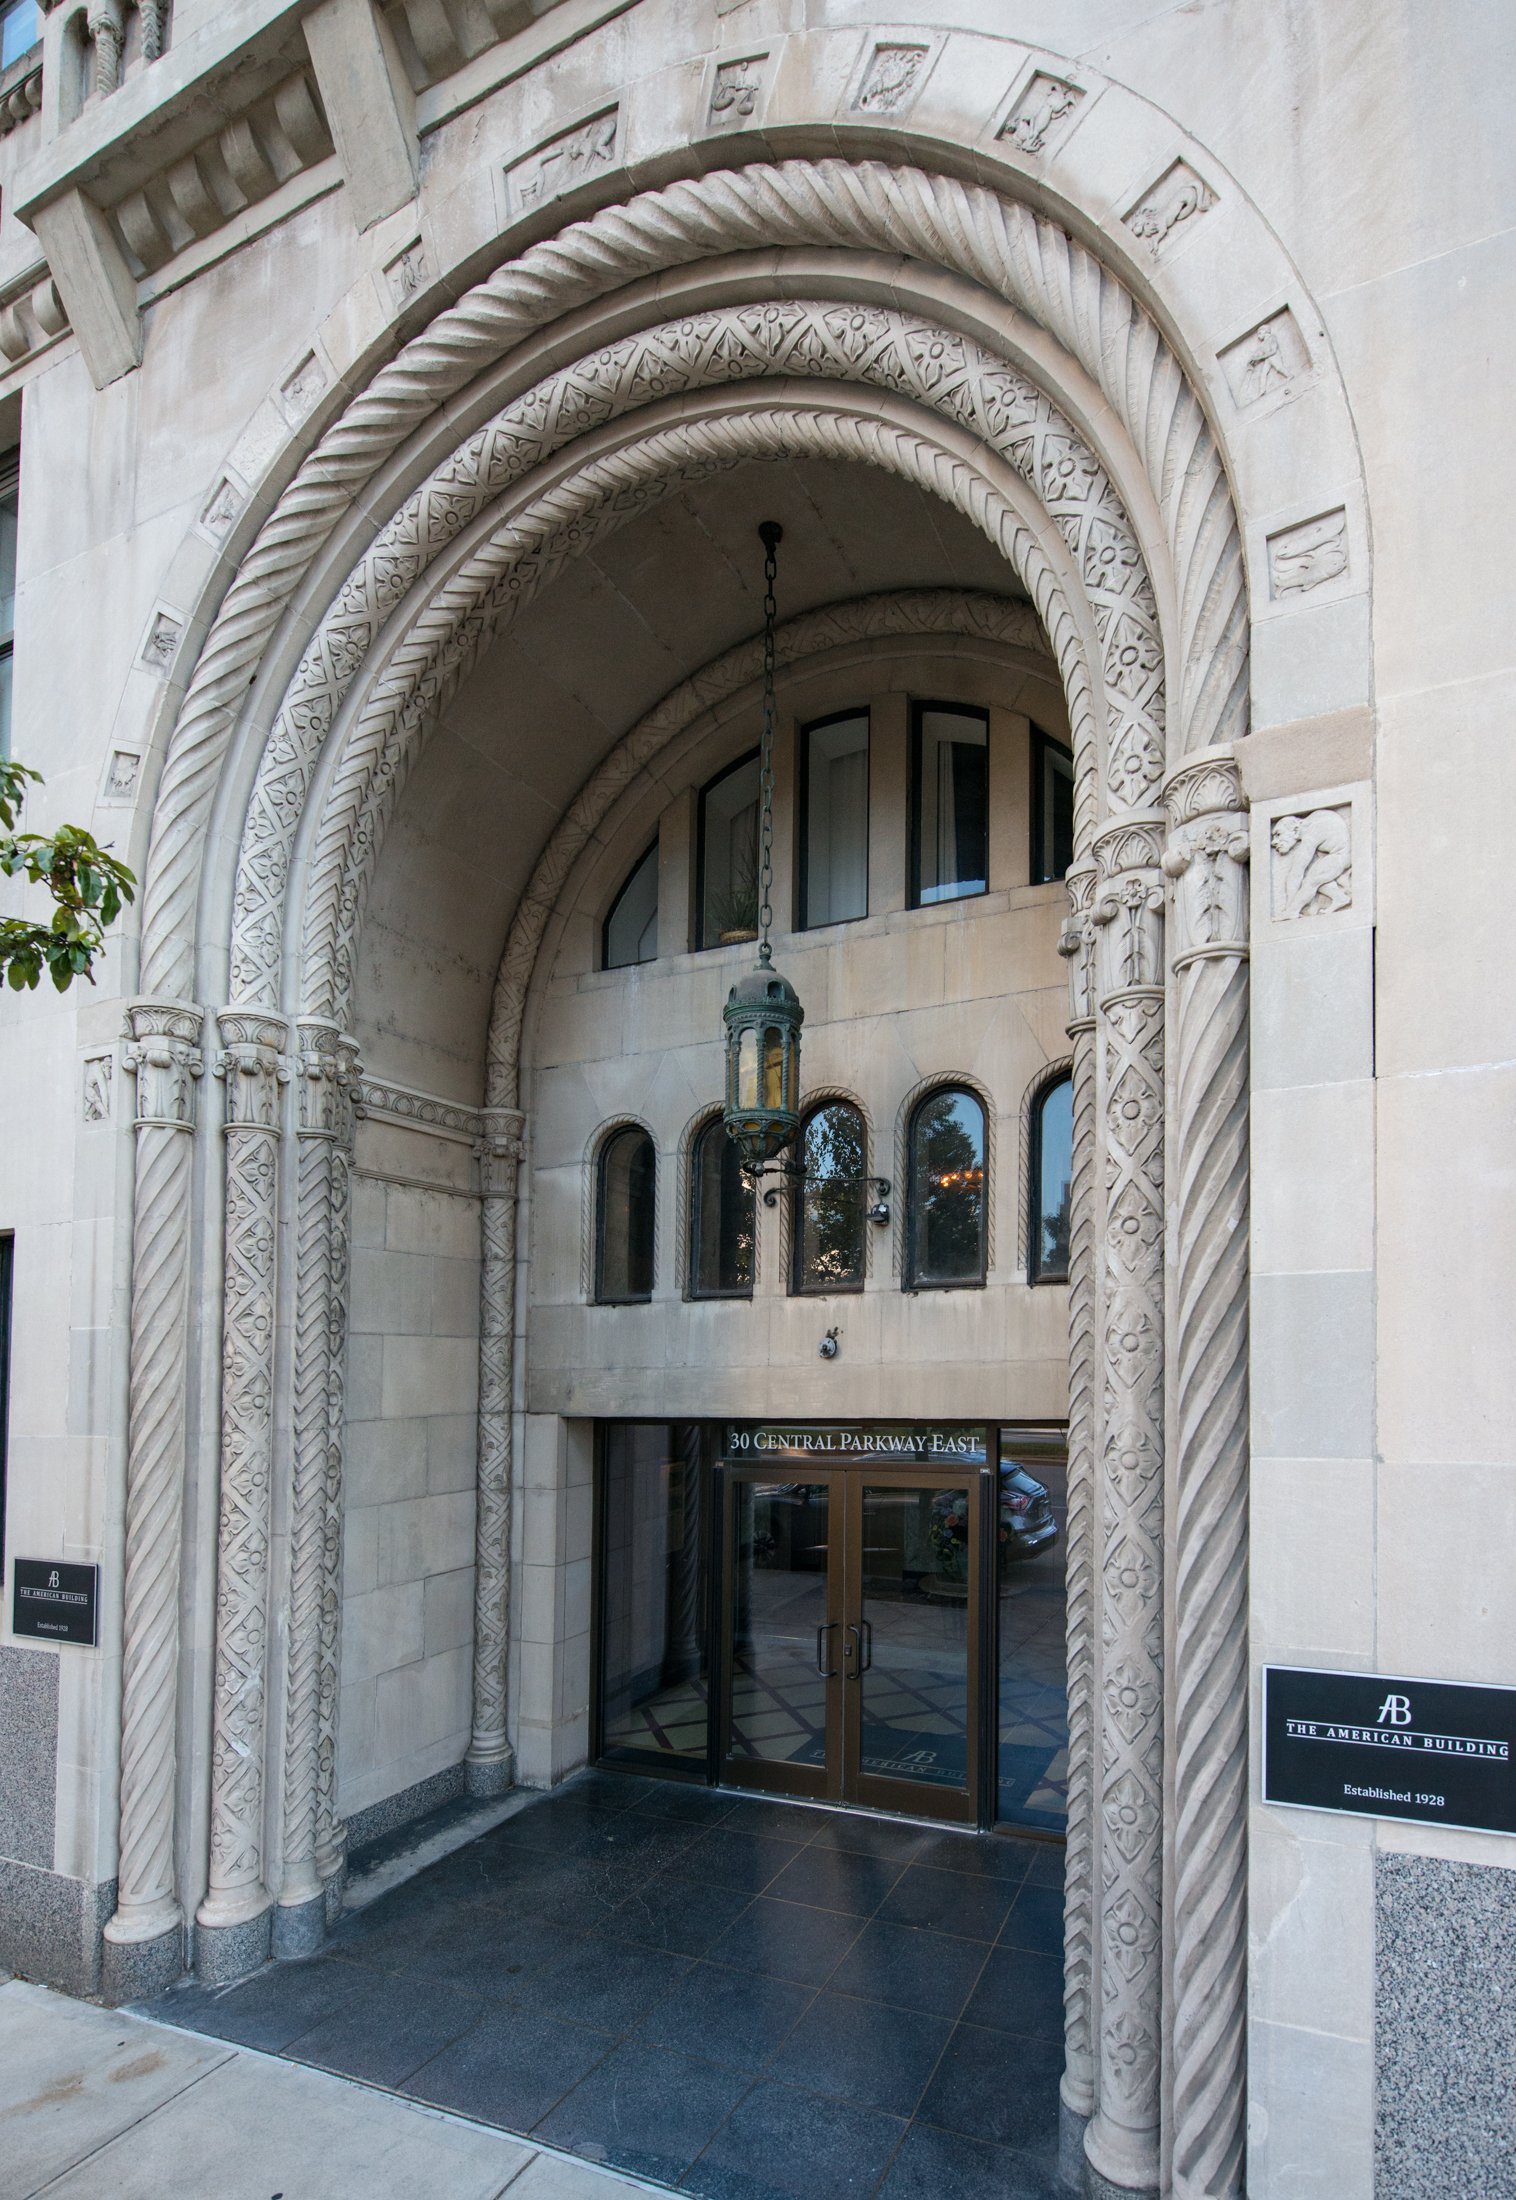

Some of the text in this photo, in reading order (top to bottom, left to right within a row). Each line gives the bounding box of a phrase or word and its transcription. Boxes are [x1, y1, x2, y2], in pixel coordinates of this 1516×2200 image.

[730, 1432, 980, 1453] 30 CENTRAL PARKWAY EAST
[48, 1571, 60, 1588] AB
[20, 1588, 88, 1603] THE AMERICAN BUILDING
[1376, 1694, 1412, 1725] AB
[1286, 1722, 1509, 1757] THE AMERICAN BUILDING
[861, 1758, 927, 1774] MERICAN
[1344, 1784, 1445, 1807] Established 1928
